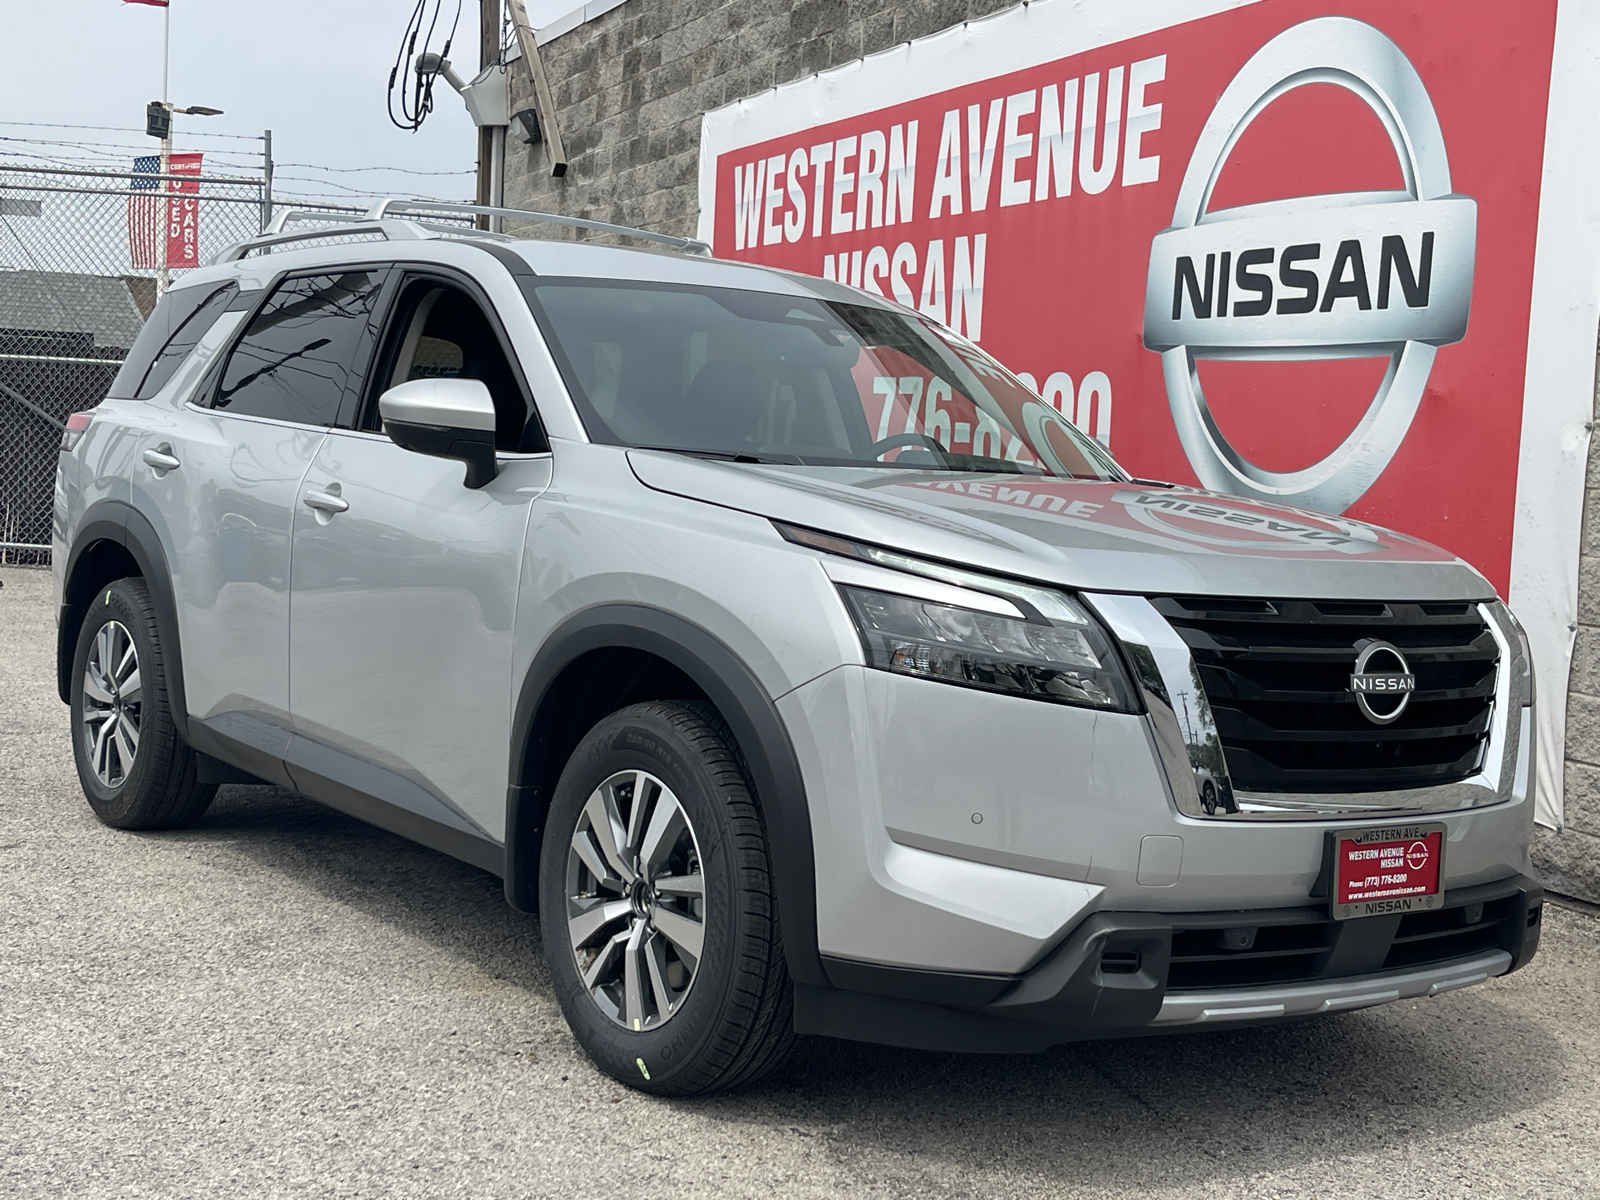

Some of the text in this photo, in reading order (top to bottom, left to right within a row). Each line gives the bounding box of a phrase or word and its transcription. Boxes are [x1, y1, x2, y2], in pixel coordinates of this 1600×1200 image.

[734, 54, 1167, 251] WESTERN AVENUE
[1171, 231, 1435, 321] NISSAN
[1353, 677, 1415, 690] NISSAN
[1362, 828, 1401, 841] WESTERN
[1348, 847, 1405, 861] WESTERN AVENUE
[1380, 858, 1404, 869] NISSAN
[1364, 876, 1380, 888] (773)
[1380, 873, 1408, 885] 776-8200
[1348, 885, 1426, 900] www.westernavenissan.com
[1365, 898, 1412, 914] NISSAN
